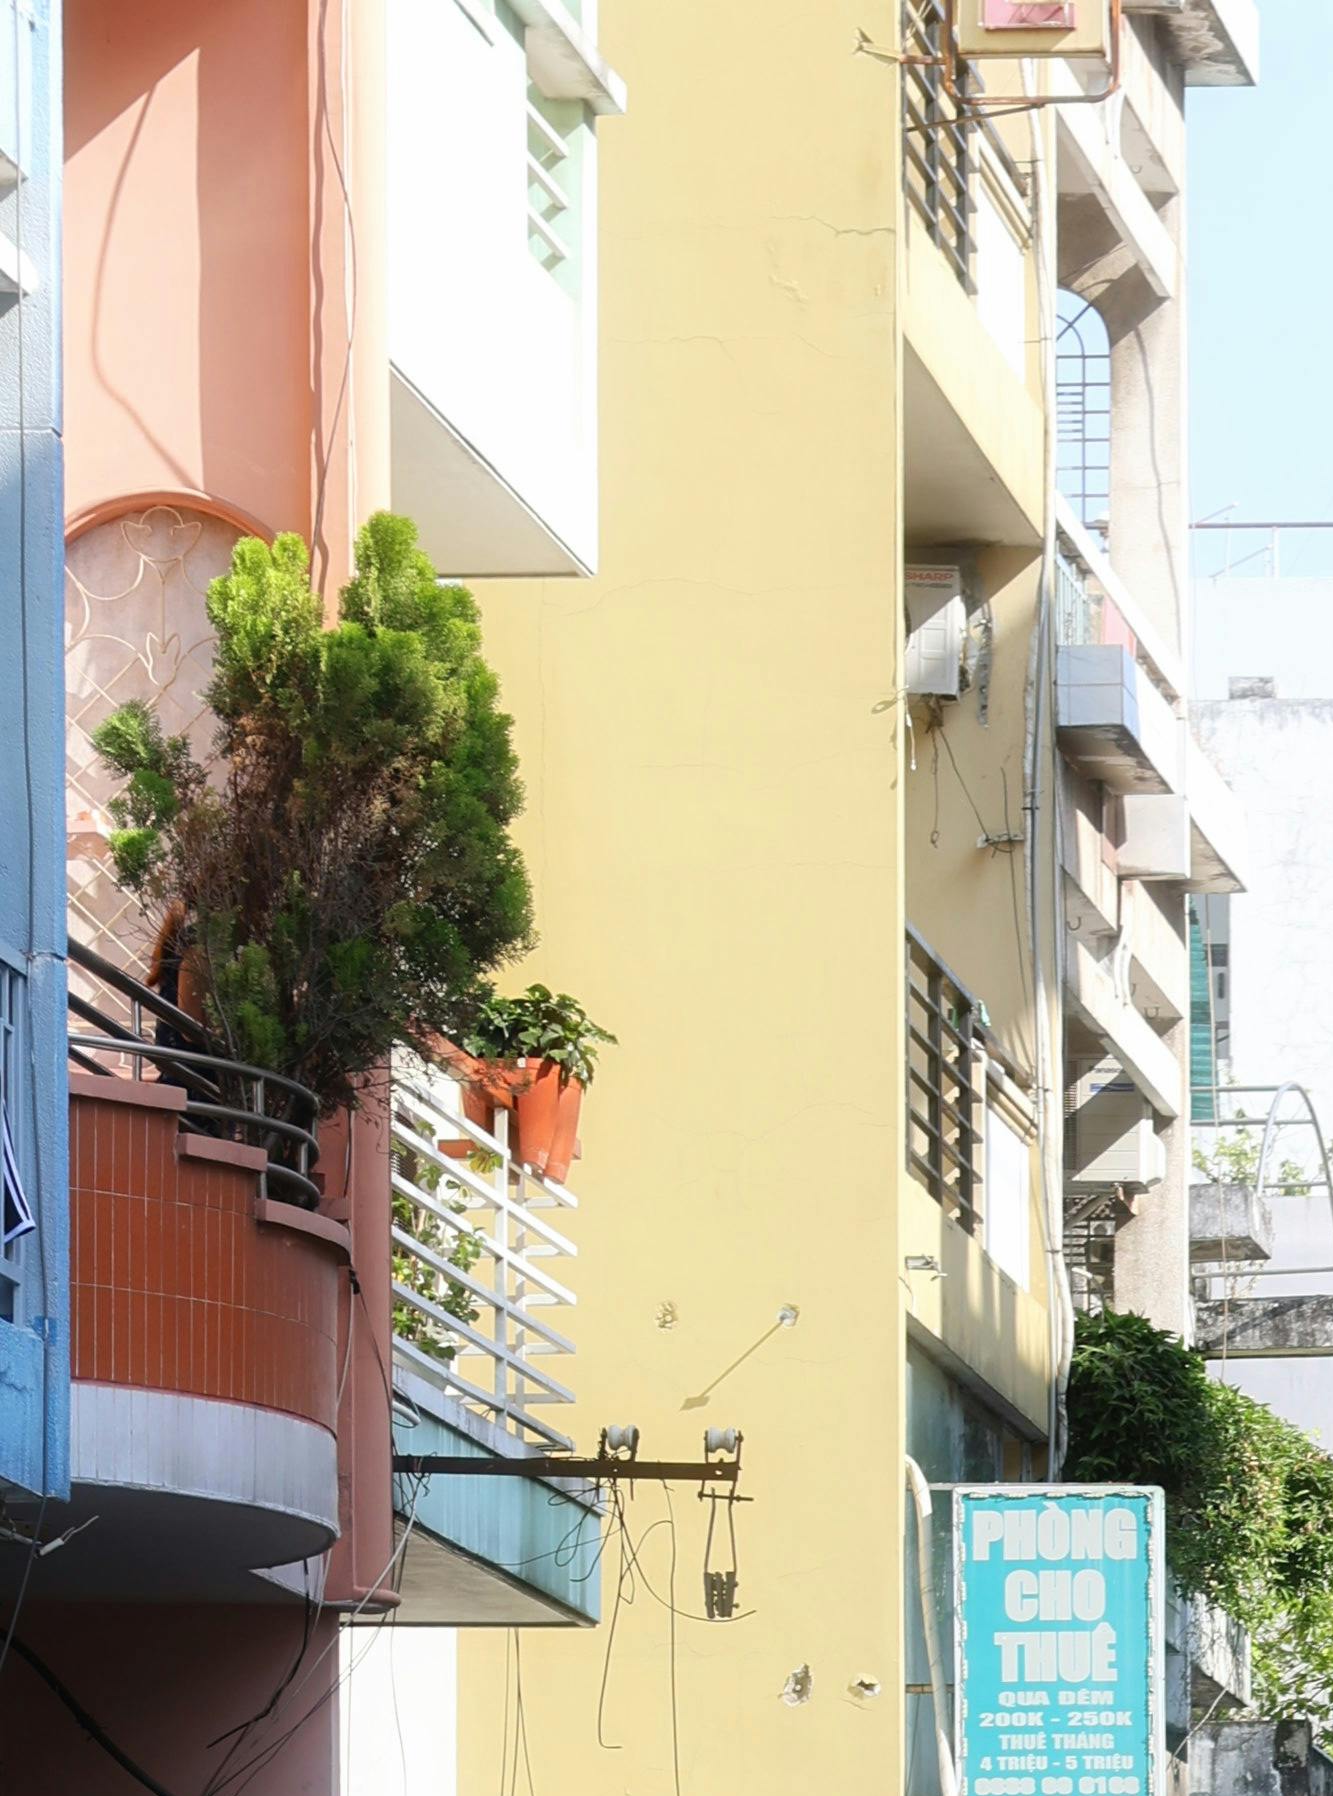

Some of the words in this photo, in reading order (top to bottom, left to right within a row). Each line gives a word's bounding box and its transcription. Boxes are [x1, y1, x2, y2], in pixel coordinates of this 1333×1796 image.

[904, 572, 953, 581] SHARP
[972, 1500, 1137, 1562] PHÒNG
[1004, 1569, 1106, 1623] CHO
[994, 1622, 1118, 1683] THUÊ
[998, 1690, 1050, 1707] QUA
[979, 1711, 1044, 1727] 200K
[1067, 1711, 1133, 1727] 250K
[998, 1731, 1048, 1751] THUÊ
[1051, 1731, 1115, 1750] THÁNG
[980, 1756, 993, 1771] 4
[997, 1753, 1048, 1773] TRIỆU
[1065, 1755, 1078, 1770] 5
[1082, 1753, 1134, 1773] TRIỆU
